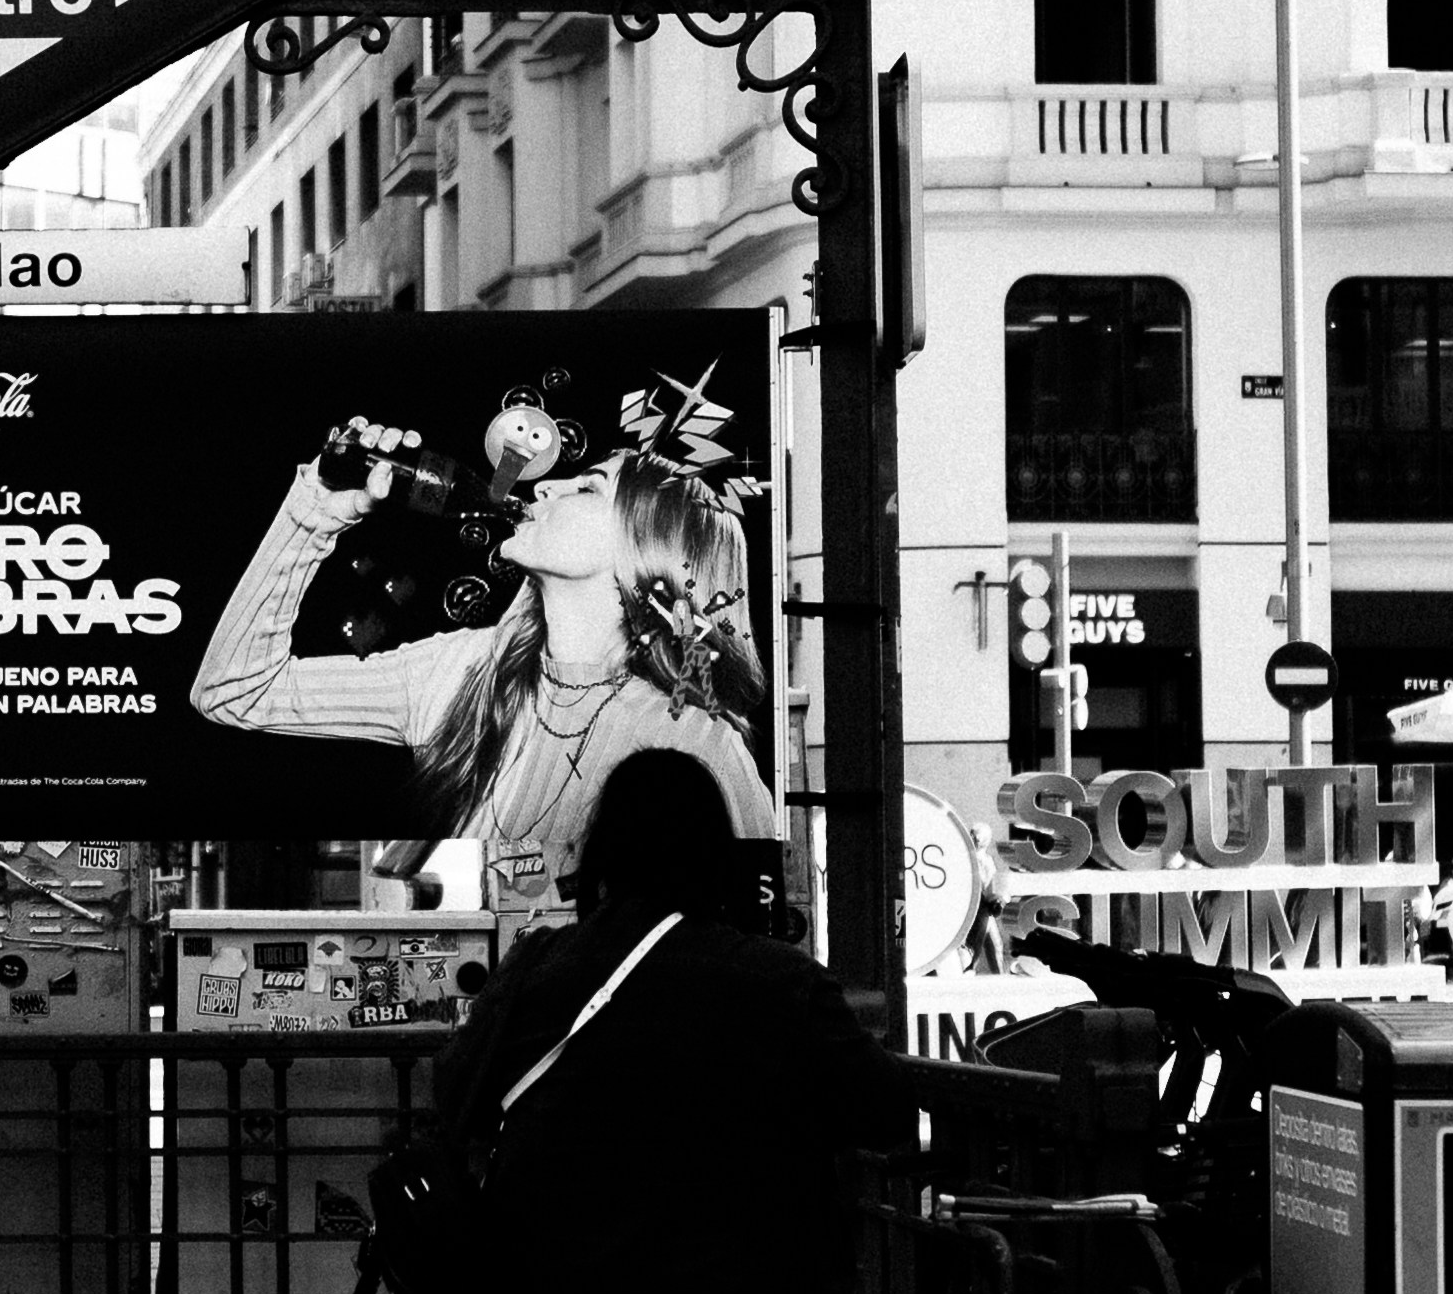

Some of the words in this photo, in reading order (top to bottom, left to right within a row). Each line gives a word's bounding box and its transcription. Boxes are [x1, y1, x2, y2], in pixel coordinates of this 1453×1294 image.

[1069, 594, 1136, 618] FIVE
[1068, 619, 1146, 644] GUYS
[67, 667, 138, 686] PARA
[1404, 678, 1439, 692] FIVE
[17, 694, 157, 714] PALABRAS
[44, 777, 60, 785] The
[997, 763, 1436, 874] SOUTH
[79, 847, 119, 869] HUS3
[264, 972, 305, 988] KOKO
[201, 995, 236, 1014] HIPPY
